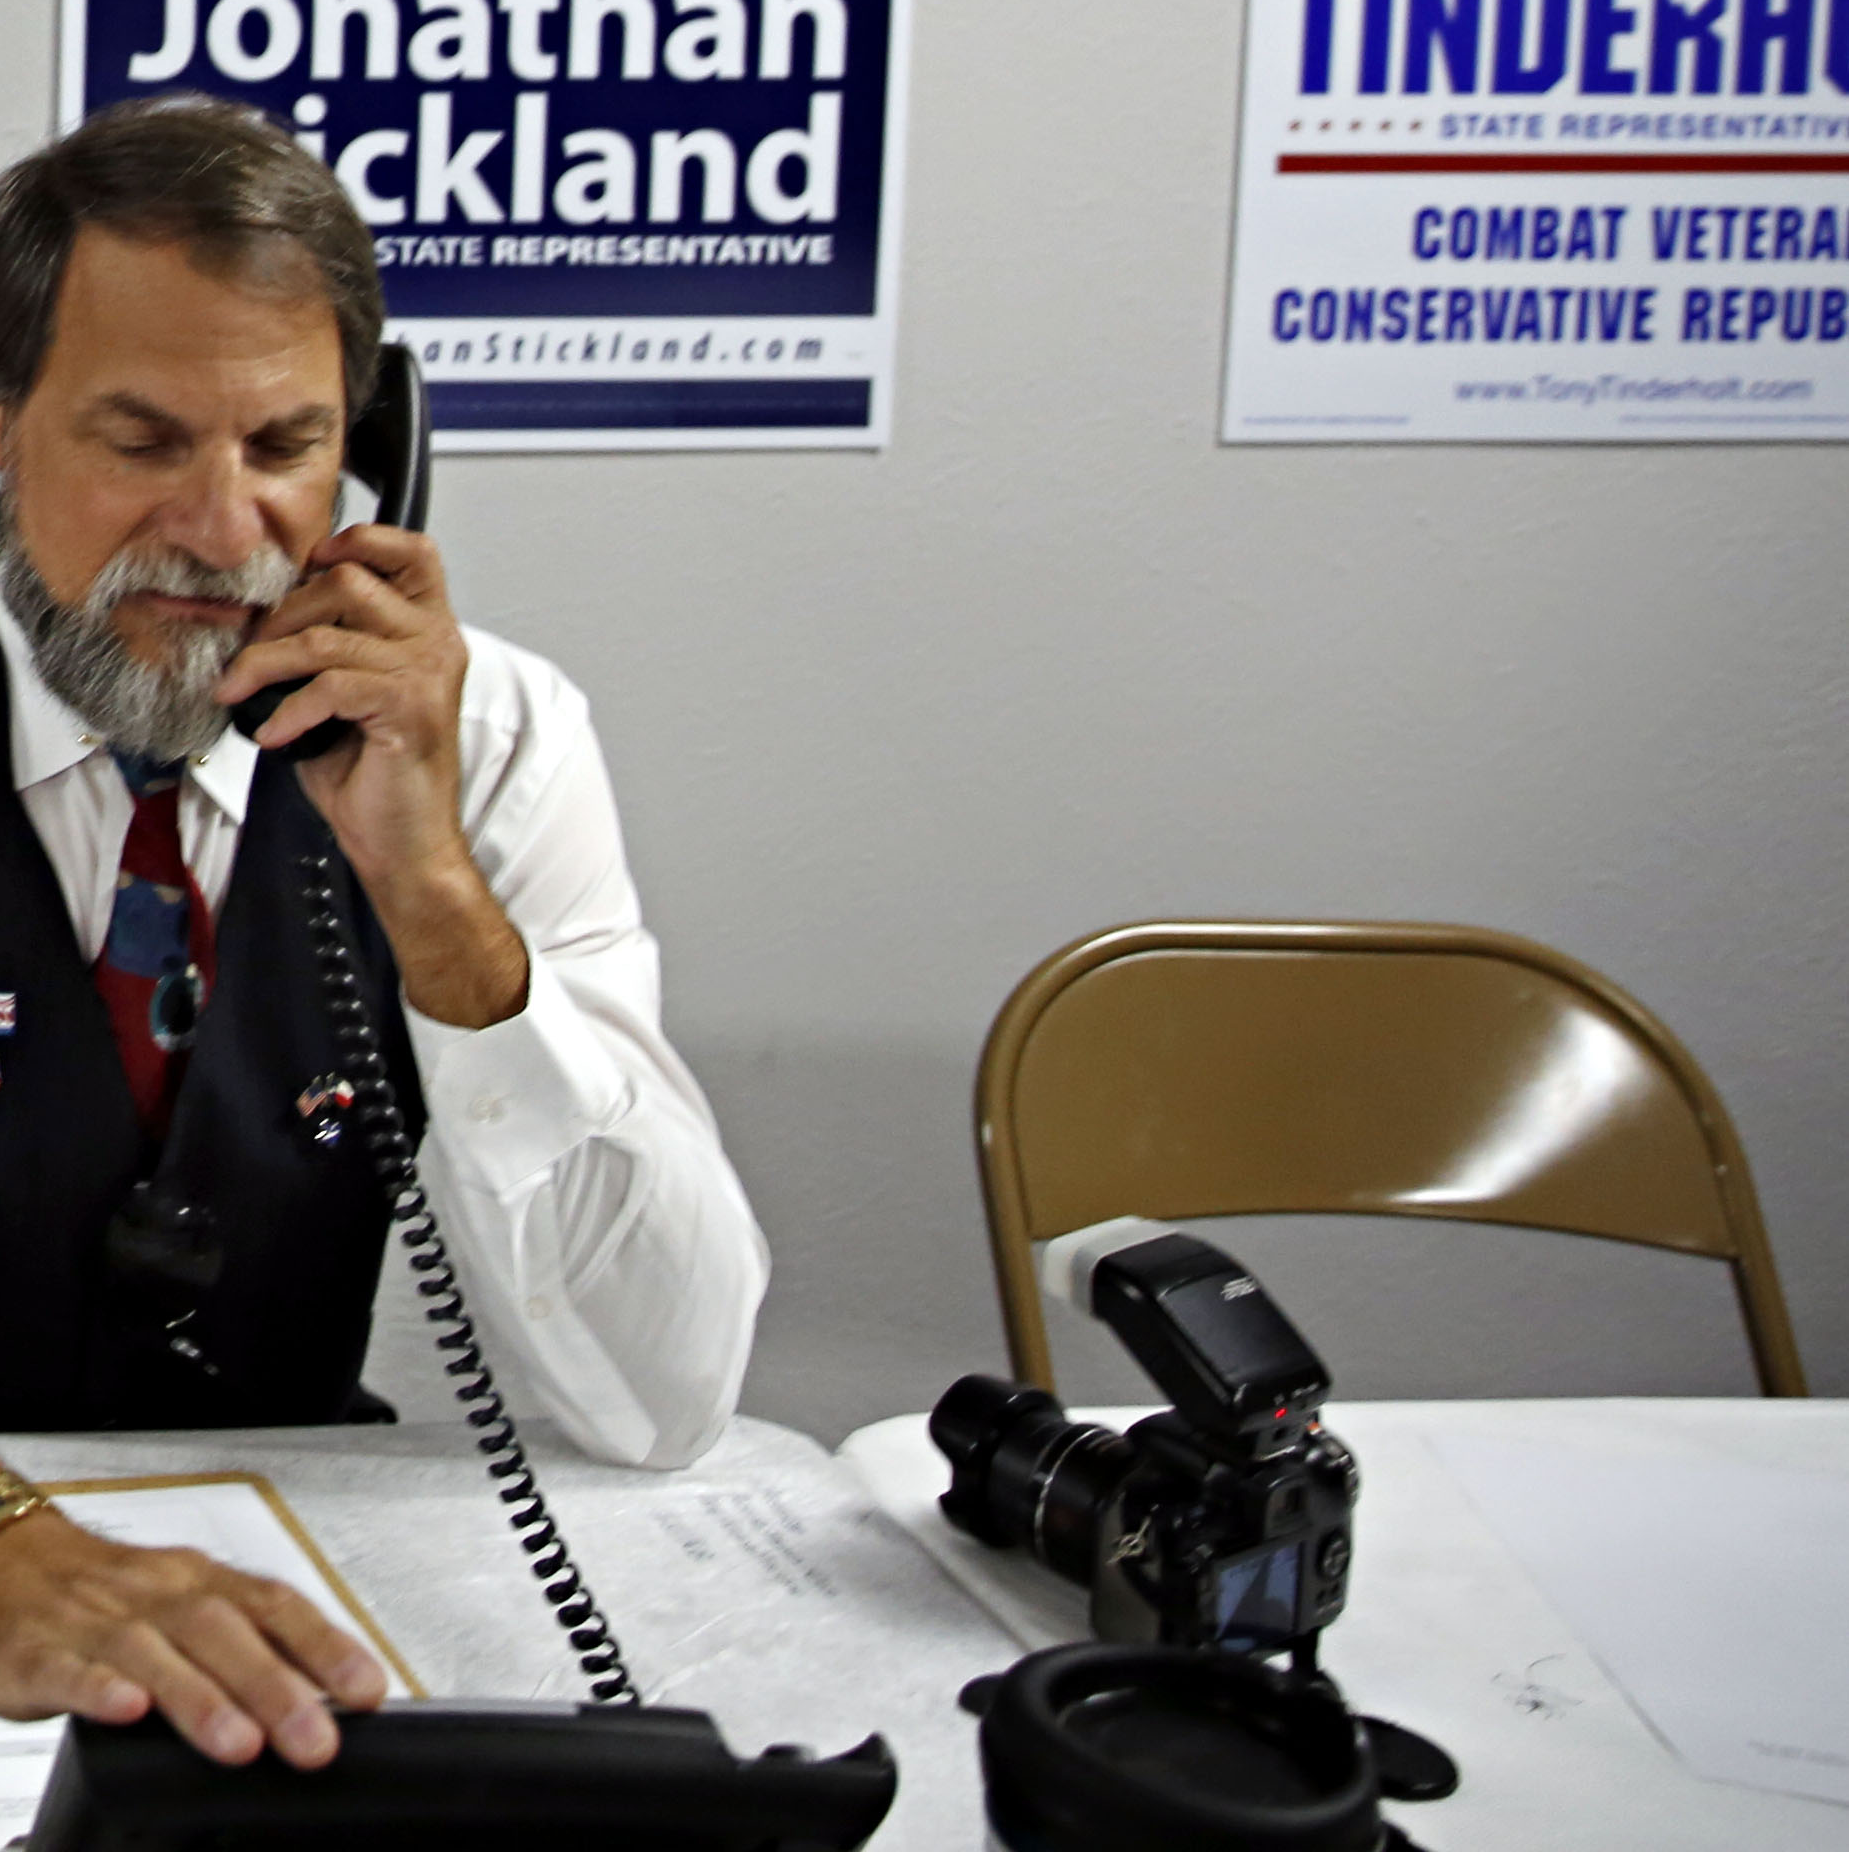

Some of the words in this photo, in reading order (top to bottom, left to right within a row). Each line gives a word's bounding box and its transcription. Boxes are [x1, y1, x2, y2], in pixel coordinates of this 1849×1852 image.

[1439, 114, 1543, 138] STATE
[492, 235, 833, 265] REPRESENTATIVE
[1413, 207, 1627, 260] COMBAT
[1653, 208, 1849, 260] VETERA
[1273, 289, 1656, 343] CONSERVATIVE
